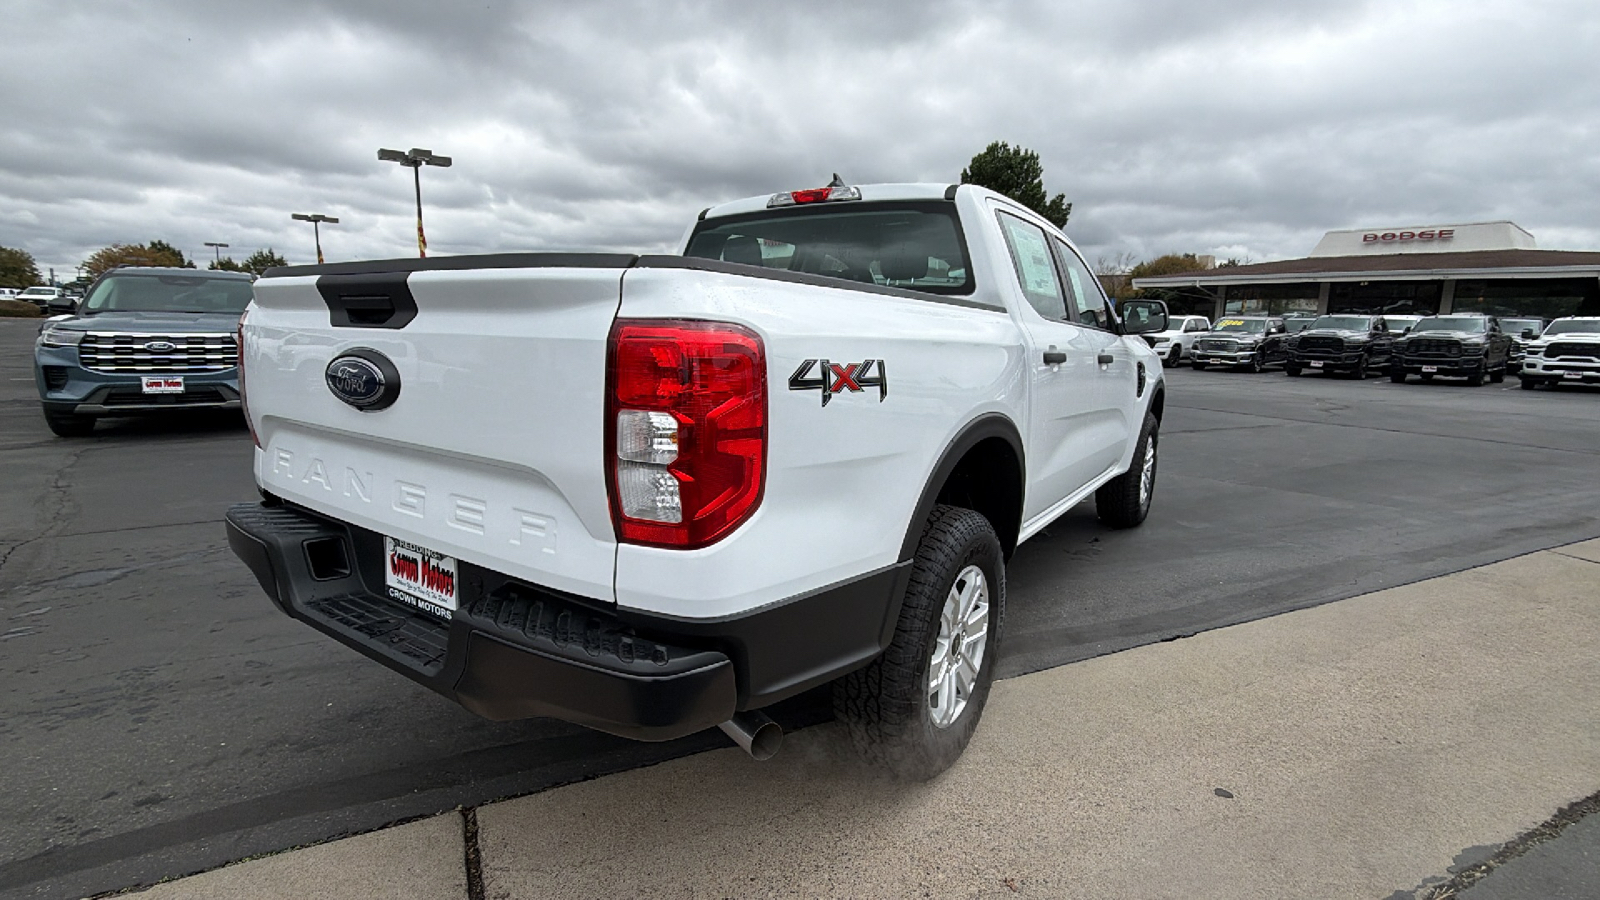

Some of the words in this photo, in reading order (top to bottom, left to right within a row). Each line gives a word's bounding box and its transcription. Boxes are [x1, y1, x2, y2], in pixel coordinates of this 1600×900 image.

[1362, 229, 1455, 243] DODGE
[336, 366, 367, 393] Ford
[273, 447, 557, 554] RANGER
[399, 540, 438, 558] REDDING
[390, 551, 419, 584] Crown
[421, 555, 454, 598] Motors
[389, 587, 417, 606] CROWN
[417, 599, 453, 620] MOTORS
